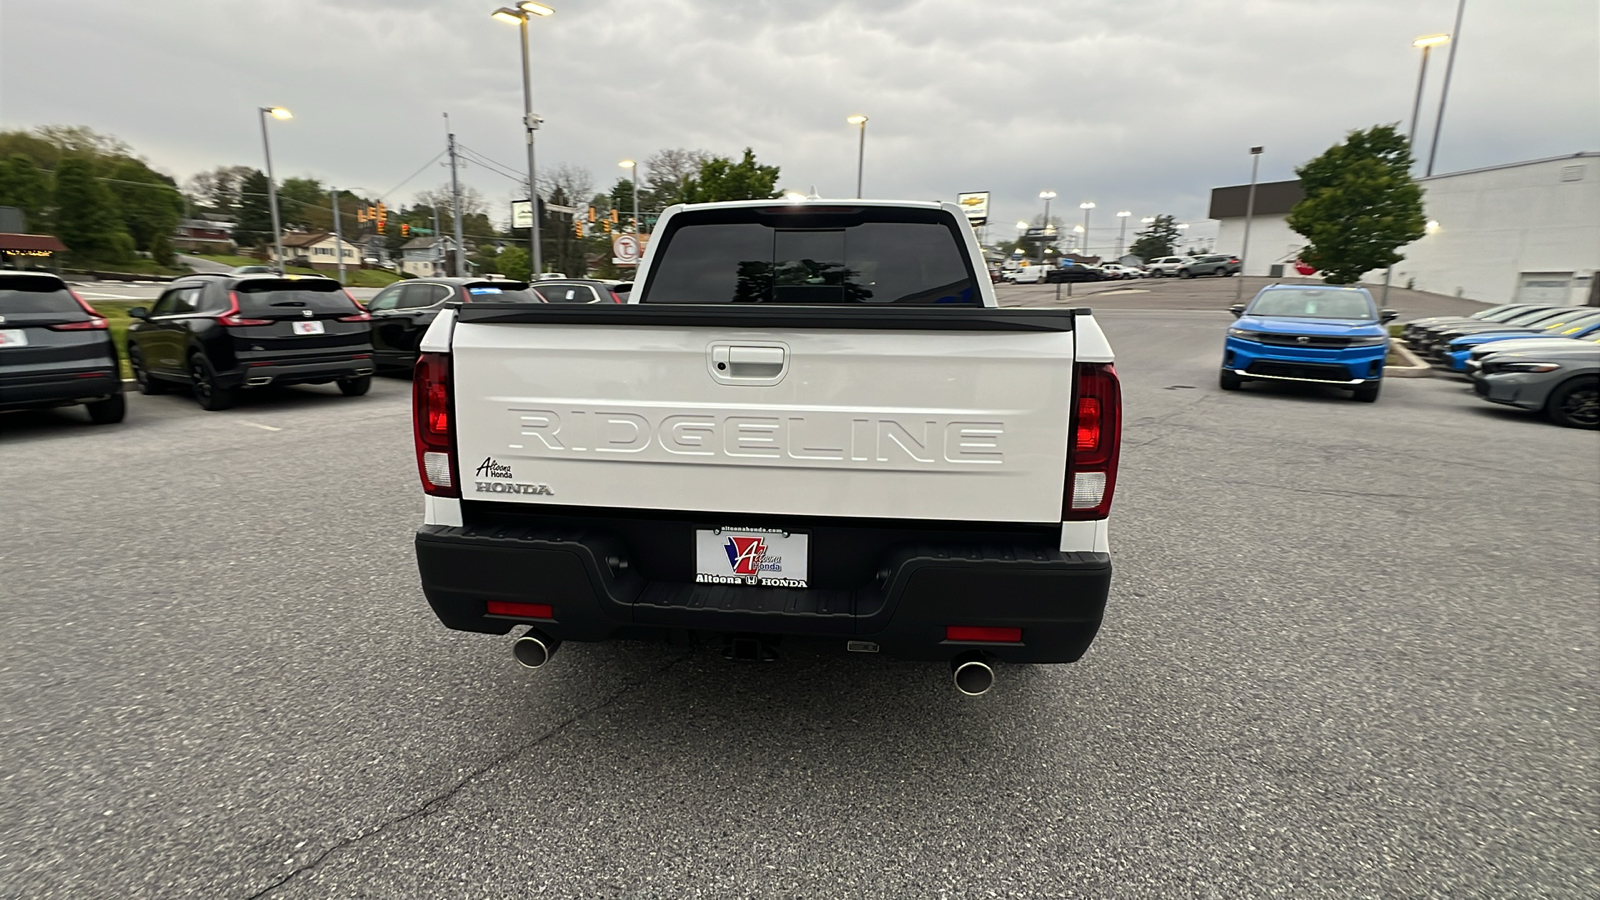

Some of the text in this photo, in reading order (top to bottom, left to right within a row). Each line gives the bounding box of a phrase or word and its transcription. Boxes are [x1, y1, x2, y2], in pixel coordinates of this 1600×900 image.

[507, 408, 1004, 464] RIDGELINE
[475, 456, 511, 478] Altoona
[490, 470, 513, 479] Honda
[475, 481, 555, 496] HONDA
[721, 526, 783, 534] altoonahonda.com
[752, 561, 782, 571] Honda
[695, 573, 808, 588] Altoona HONDA
